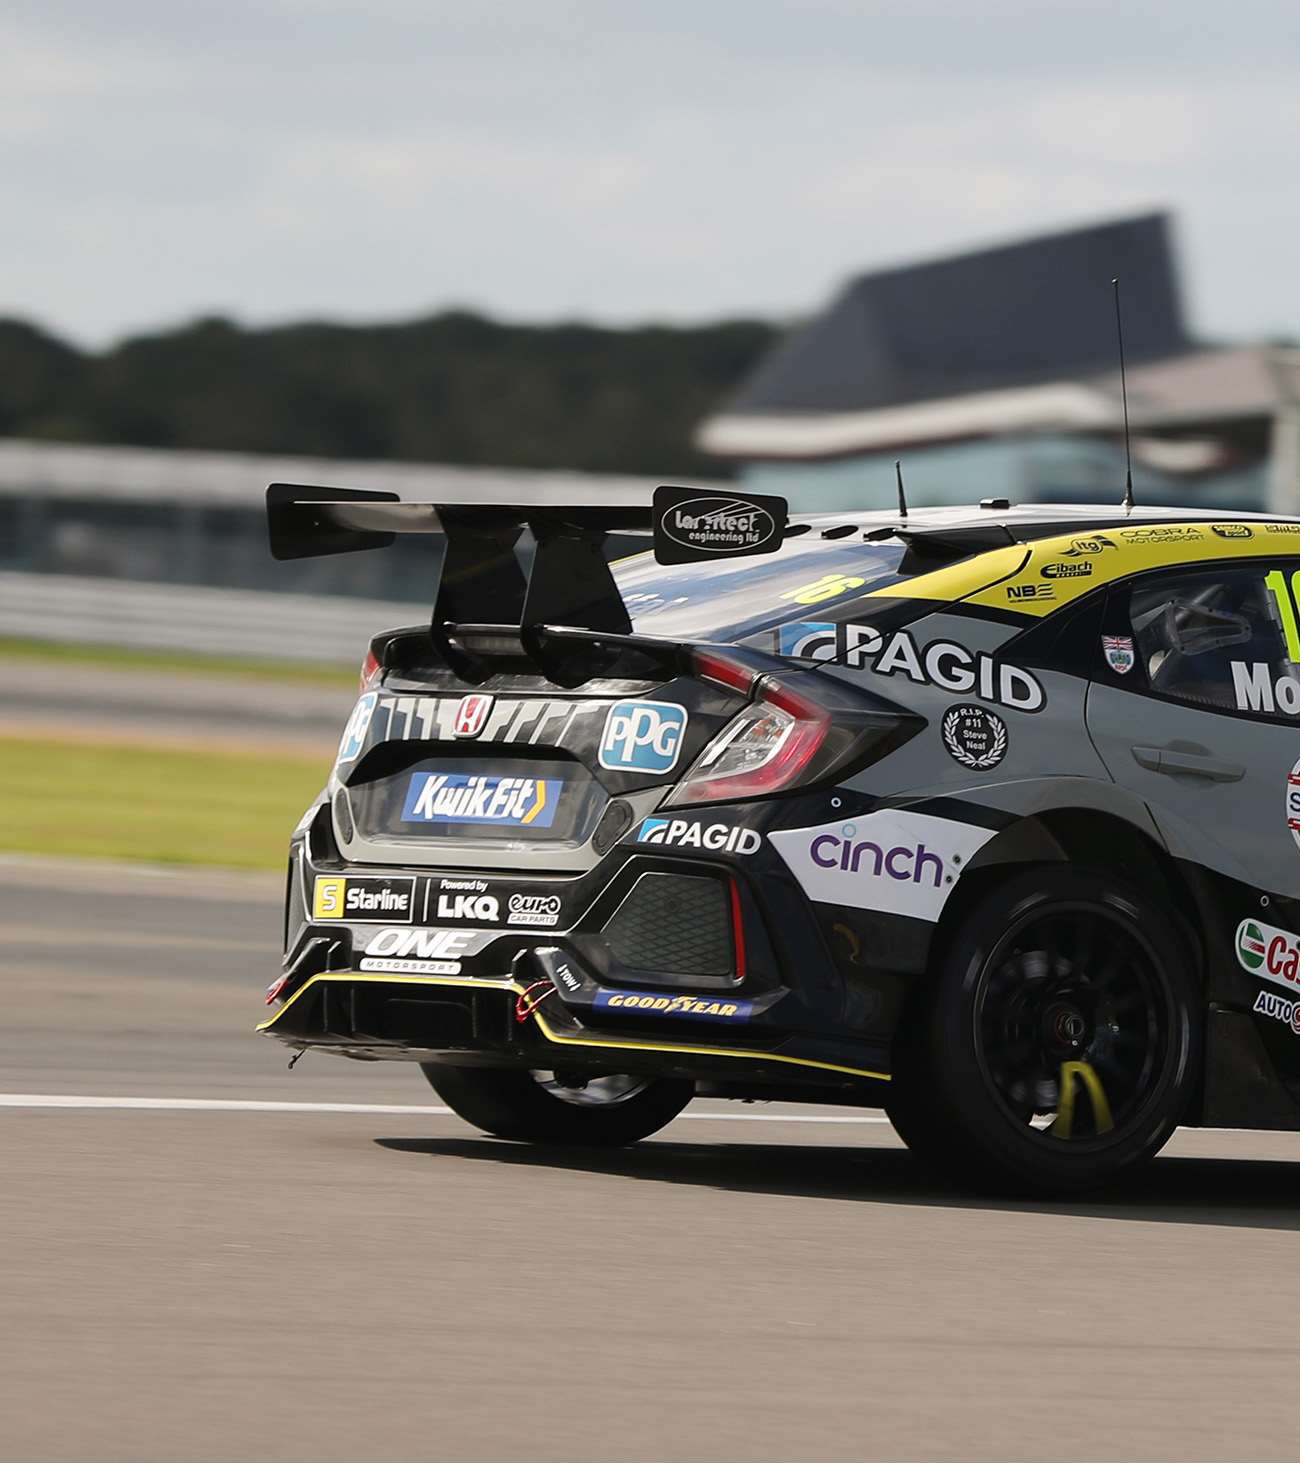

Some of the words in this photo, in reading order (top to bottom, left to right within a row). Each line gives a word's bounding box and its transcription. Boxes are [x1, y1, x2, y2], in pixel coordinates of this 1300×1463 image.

[689, 531, 744, 544] engineering
[1120, 528, 1202, 538] COBRA
[1040, 561, 1093, 579] Eibach
[779, 574, 865, 604] 16
[846, 623, 1043, 711] PAGID
[604, 707, 681, 763] PPG
[963, 729, 987, 740] Steve
[965, 719, 981, 729] #11
[966, 740, 986, 751] Neal
[665, 819, 762, 855] PAGID
[810, 823, 944, 888] cinch
[440, 879, 476, 891] Powered
[475, 881, 488, 893] by
[322, 885, 338, 911] S
[346, 888, 409, 911] Starline
[437, 895, 500, 922] LKQ
[509, 894, 561, 914] euro
[364, 928, 477, 960] ONE
[366, 961, 454, 971] MOTORSPORT
[607, 994, 738, 1018] GOODYEAR
